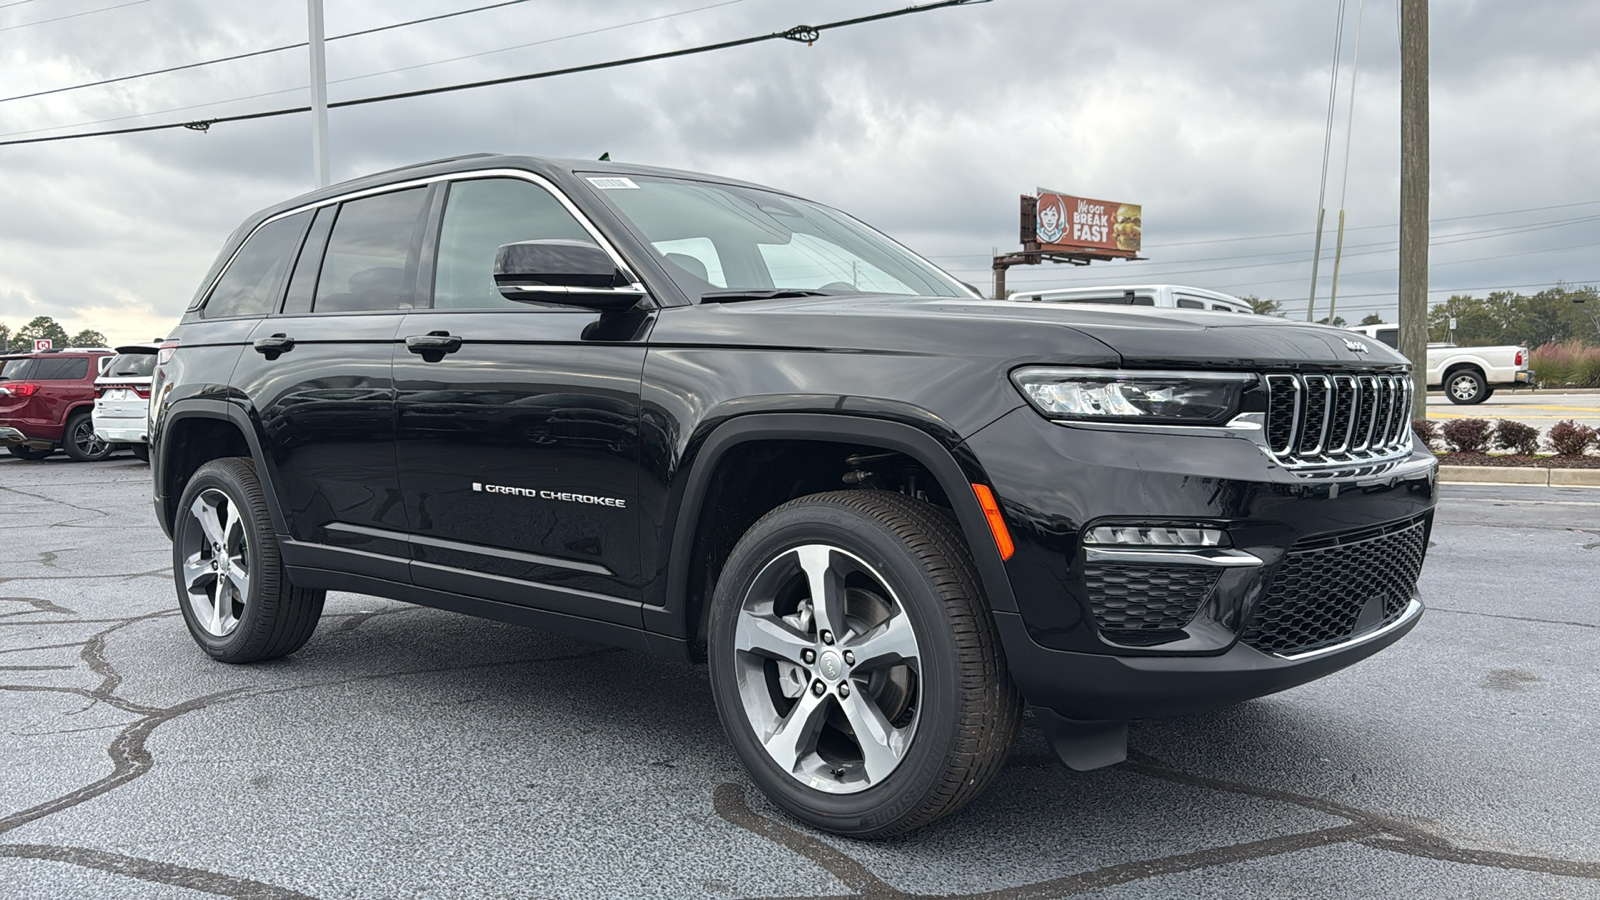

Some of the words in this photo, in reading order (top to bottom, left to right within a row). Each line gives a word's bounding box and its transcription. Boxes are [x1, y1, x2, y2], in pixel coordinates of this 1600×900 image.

[1077, 199, 1088, 214] We
[1088, 204, 1104, 214] GOT
[1073, 211, 1108, 226] BREAK
[1073, 223, 1108, 242] FAST
[485, 484, 536, 497] GRAND
[540, 490, 626, 508] CHEROKEE
